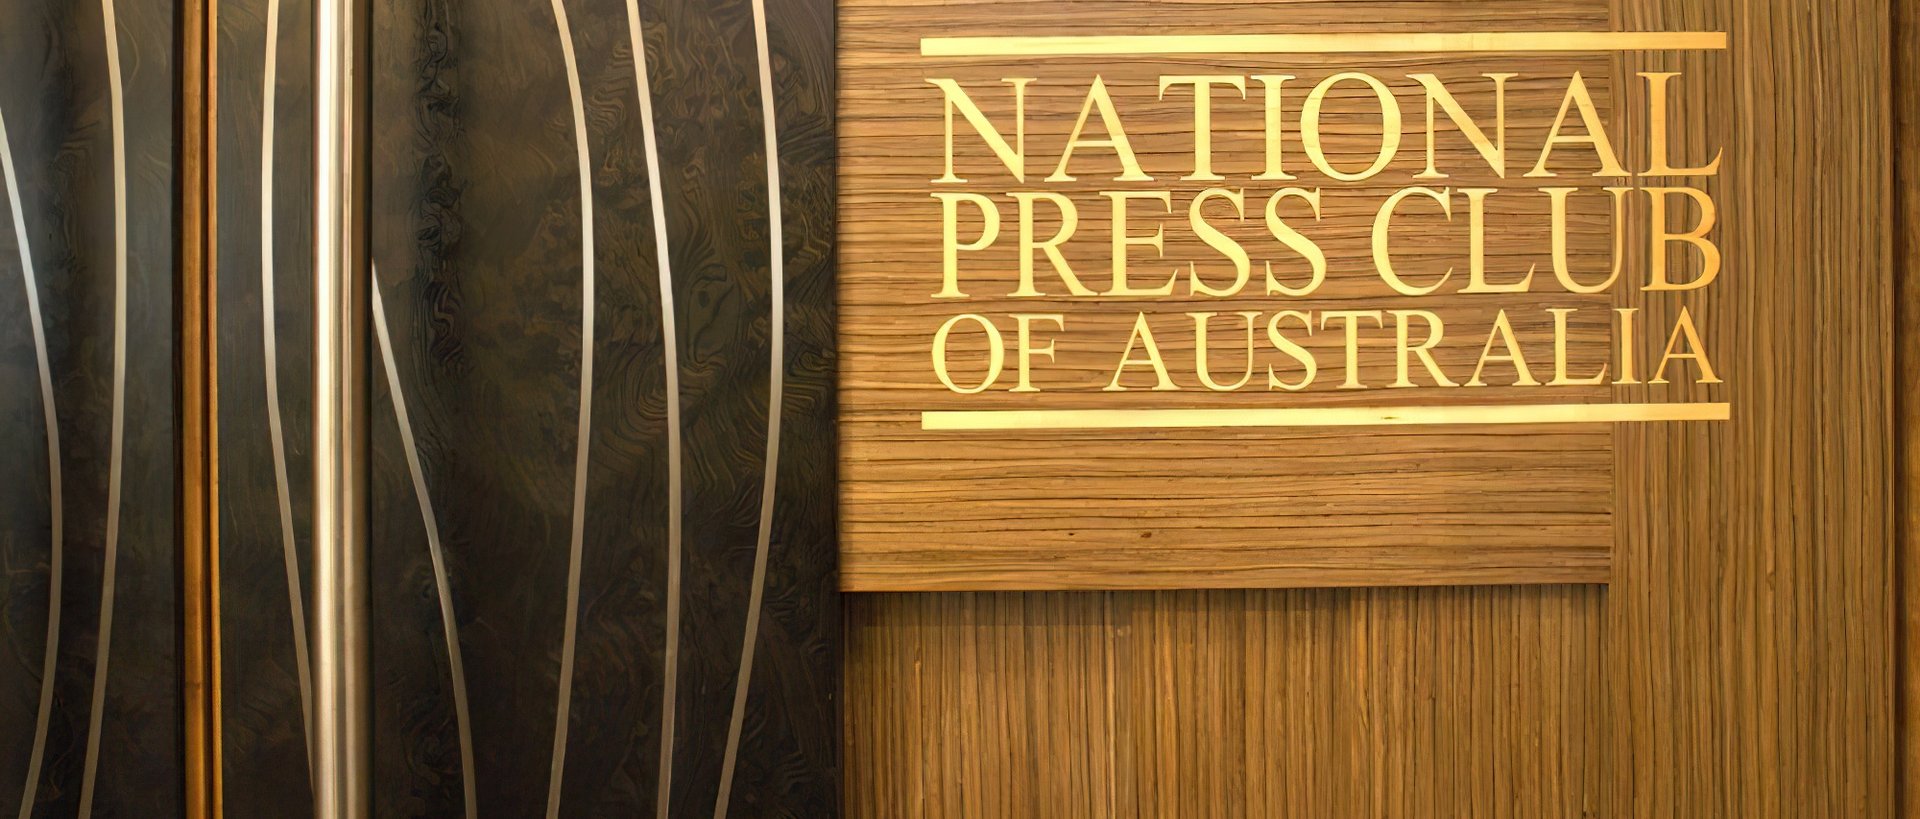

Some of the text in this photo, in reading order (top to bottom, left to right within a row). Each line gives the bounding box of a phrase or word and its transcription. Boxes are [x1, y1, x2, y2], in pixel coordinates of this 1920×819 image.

[924, 70, 1723, 184] NATIONAL
[930, 186, 1721, 298] PRESS CLUB
[931, 306, 1723, 394] OF AUSTRALIA
